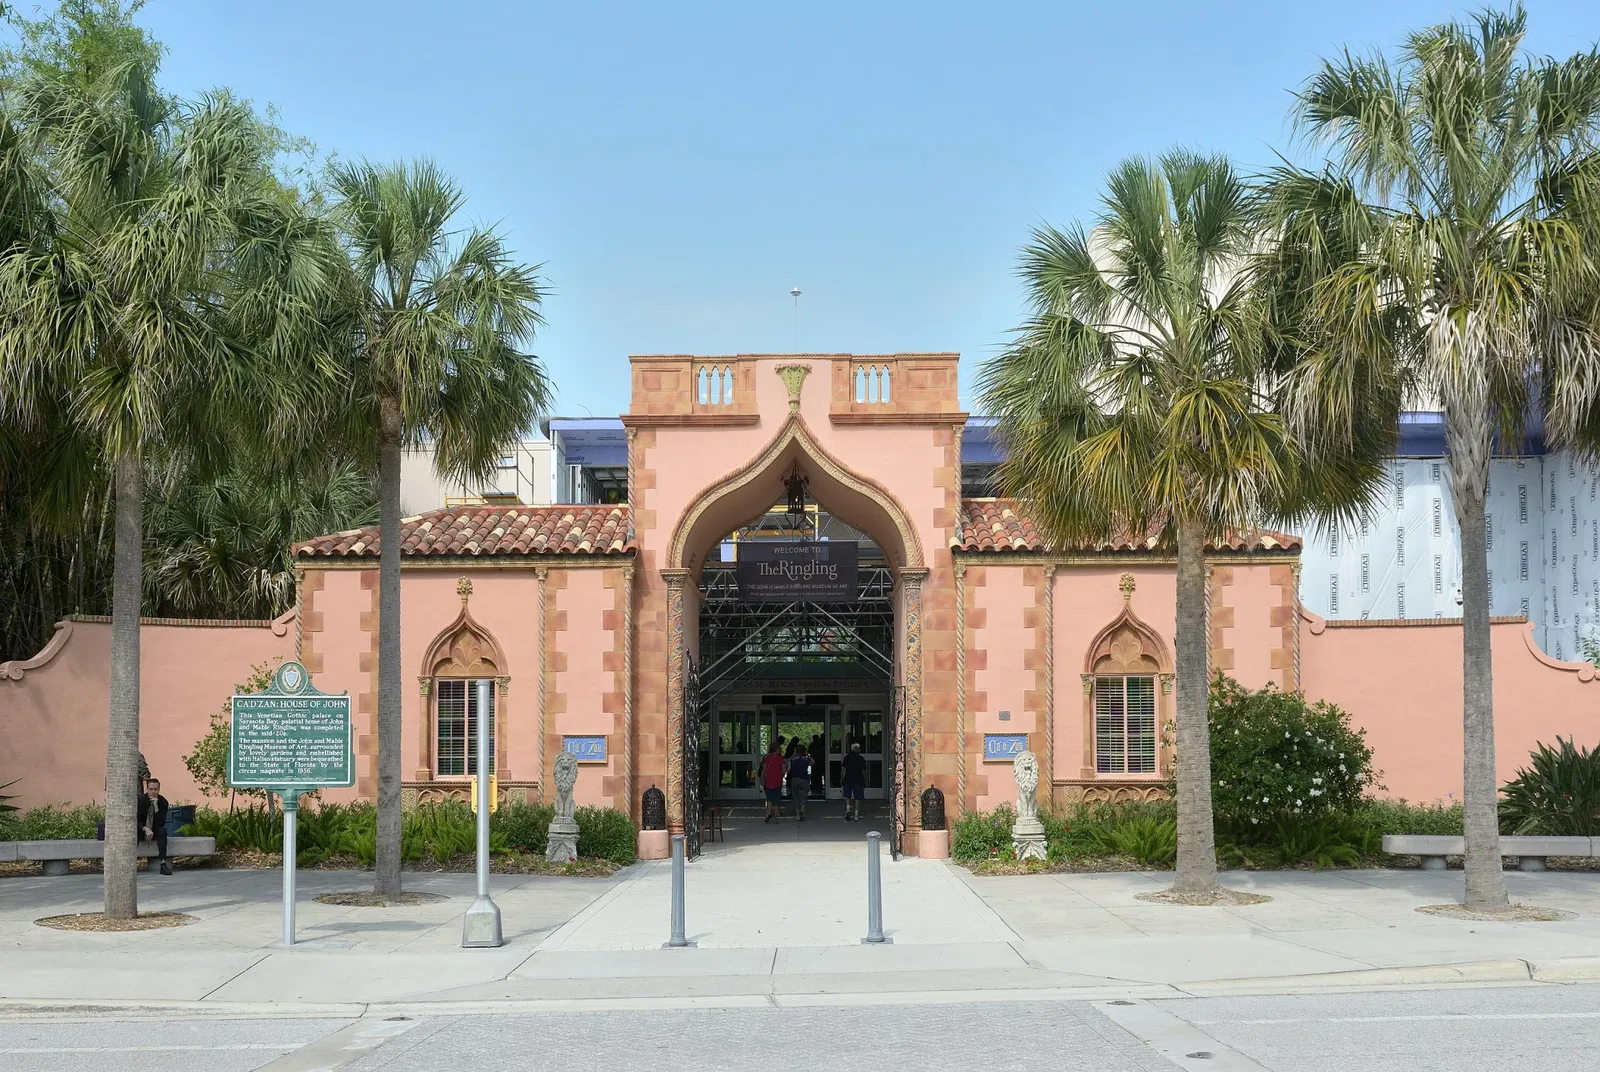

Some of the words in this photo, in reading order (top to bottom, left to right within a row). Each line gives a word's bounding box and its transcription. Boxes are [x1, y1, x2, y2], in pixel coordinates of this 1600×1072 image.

[1361, 556, 1369, 591] EVERBILT
[280, 700, 308, 708] HOUSE
[310, 700, 320, 708] OF
[323, 700, 346, 708] JOHN
